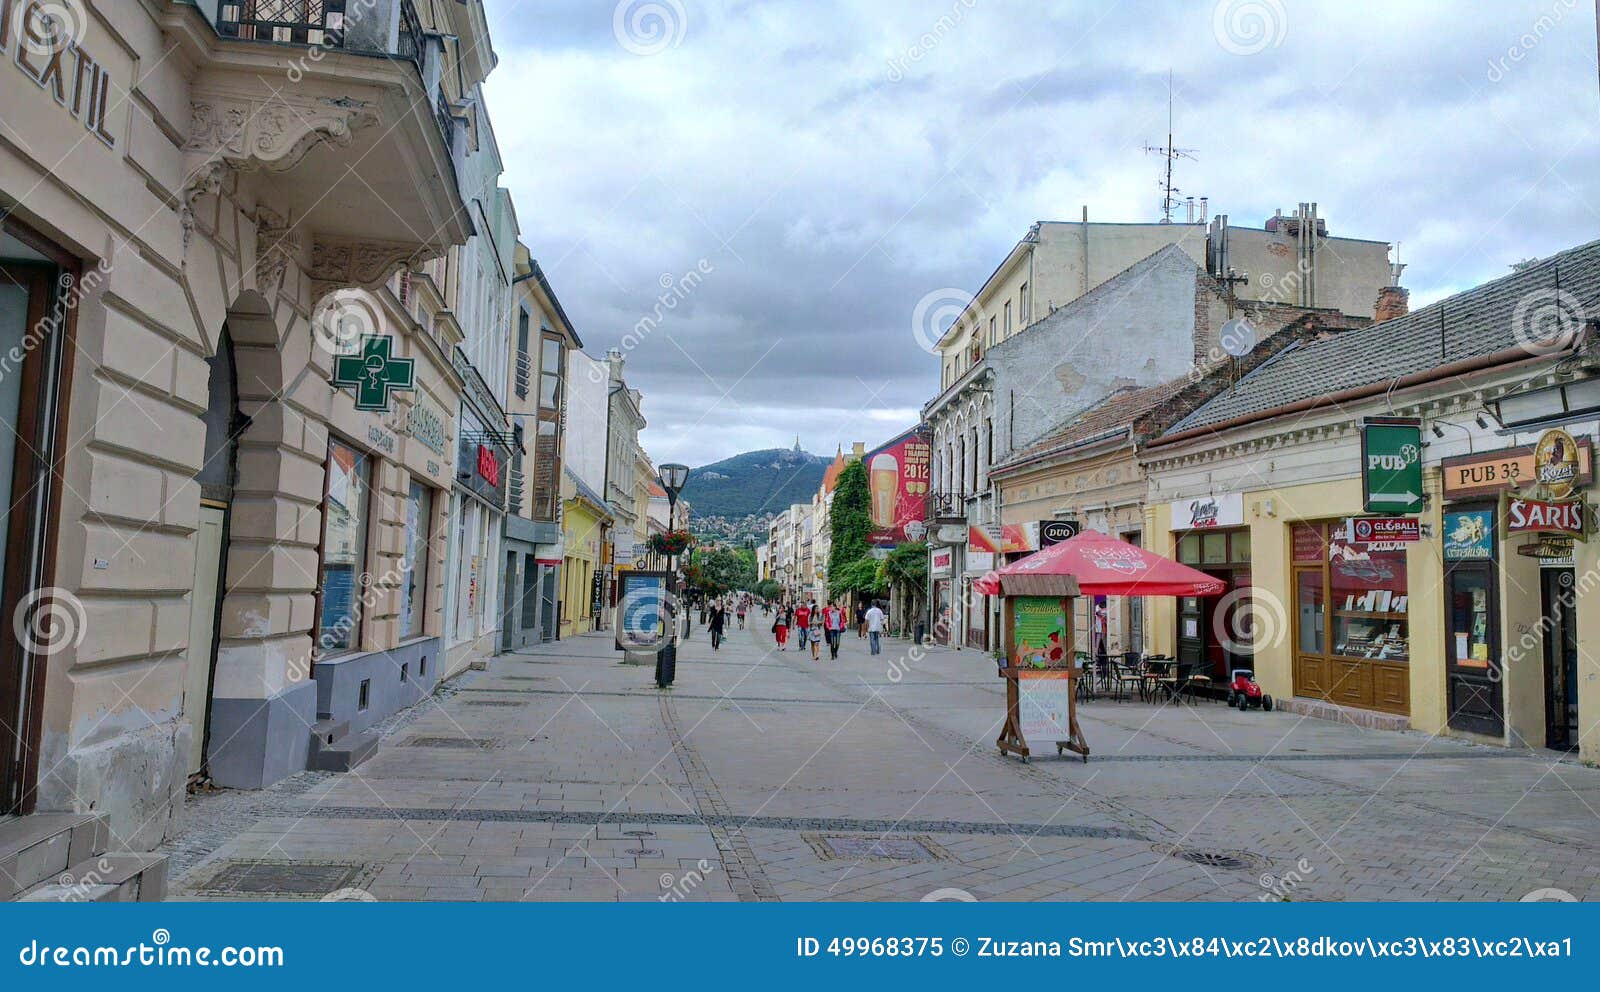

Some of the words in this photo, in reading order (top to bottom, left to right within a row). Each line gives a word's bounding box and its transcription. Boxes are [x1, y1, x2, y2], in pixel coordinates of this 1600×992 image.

[1367, 455, 1407, 470] PUB
[903, 464, 929, 479] 2012
[1460, 465, 1496, 485] PUB
[1501, 462, 1520, 479] 33
[1509, 497, 1583, 531] ŠARIŠ
[1048, 528, 1071, 537] DUO
